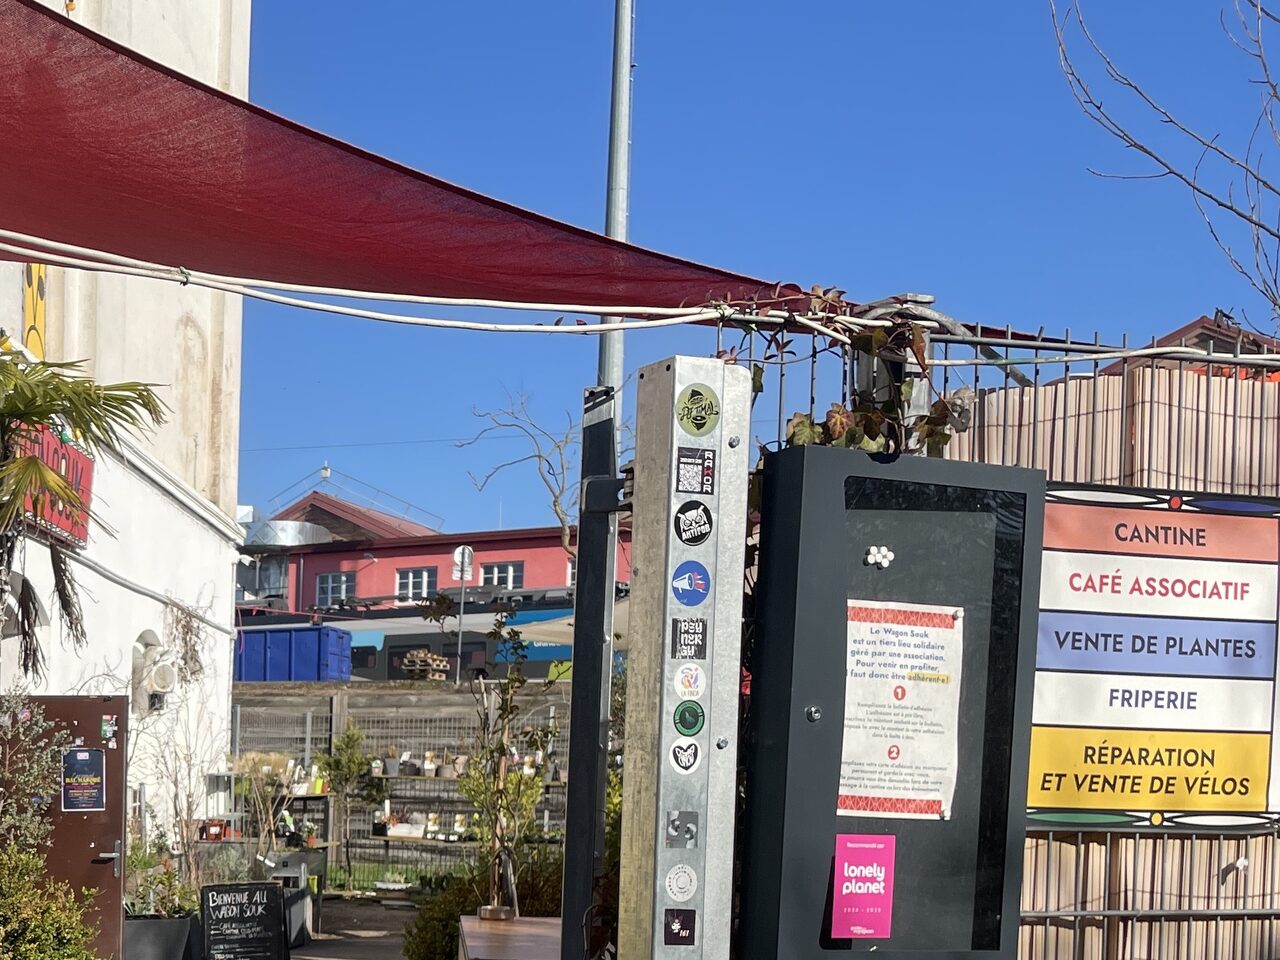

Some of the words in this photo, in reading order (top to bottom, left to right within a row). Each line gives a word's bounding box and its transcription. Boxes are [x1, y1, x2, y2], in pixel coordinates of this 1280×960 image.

[1114, 522, 1206, 547] CANTINE
[1068, 568, 1122, 595] CAFÉ
[1128, 576, 1250, 601] ASSOCIATIF
[870, 627, 880, 635] Le
[883, 628, 908, 638] Wagon
[910, 630, 929, 638] Souk
[879, 639, 896, 647] tiers
[898, 639, 911, 648] lieu
[913, 641, 945, 650] solidaire
[1054, 630, 1124, 653] VENTE
[1131, 634, 1157, 655] DE
[1165, 636, 1256, 659] PLANTES
[850, 649, 869, 657] géré
[903, 653, 946, 661] association.
[850, 669, 866, 677] faut
[868, 670, 889, 679] donc
[855, 659, 875, 667] Pour
[910, 663, 940, 673] profiter,
[1108, 688, 1198, 710] FRIPERIE
[1083, 739, 1216, 768] RÉPARATION
[1040, 773, 1067, 792] ET
[1073, 773, 1143, 794] VENTE
[1149, 776, 1176, 795] DE
[1185, 771, 1250, 796] VÉLOS
[844, 862, 885, 881] lonely
[842, 879, 885, 895] planet
[209, 891, 249, 906] BIENVENUE
[252, 890, 267, 903] AU
[210, 905, 240, 919] WAGON
[243, 903, 266, 917] SOUK
